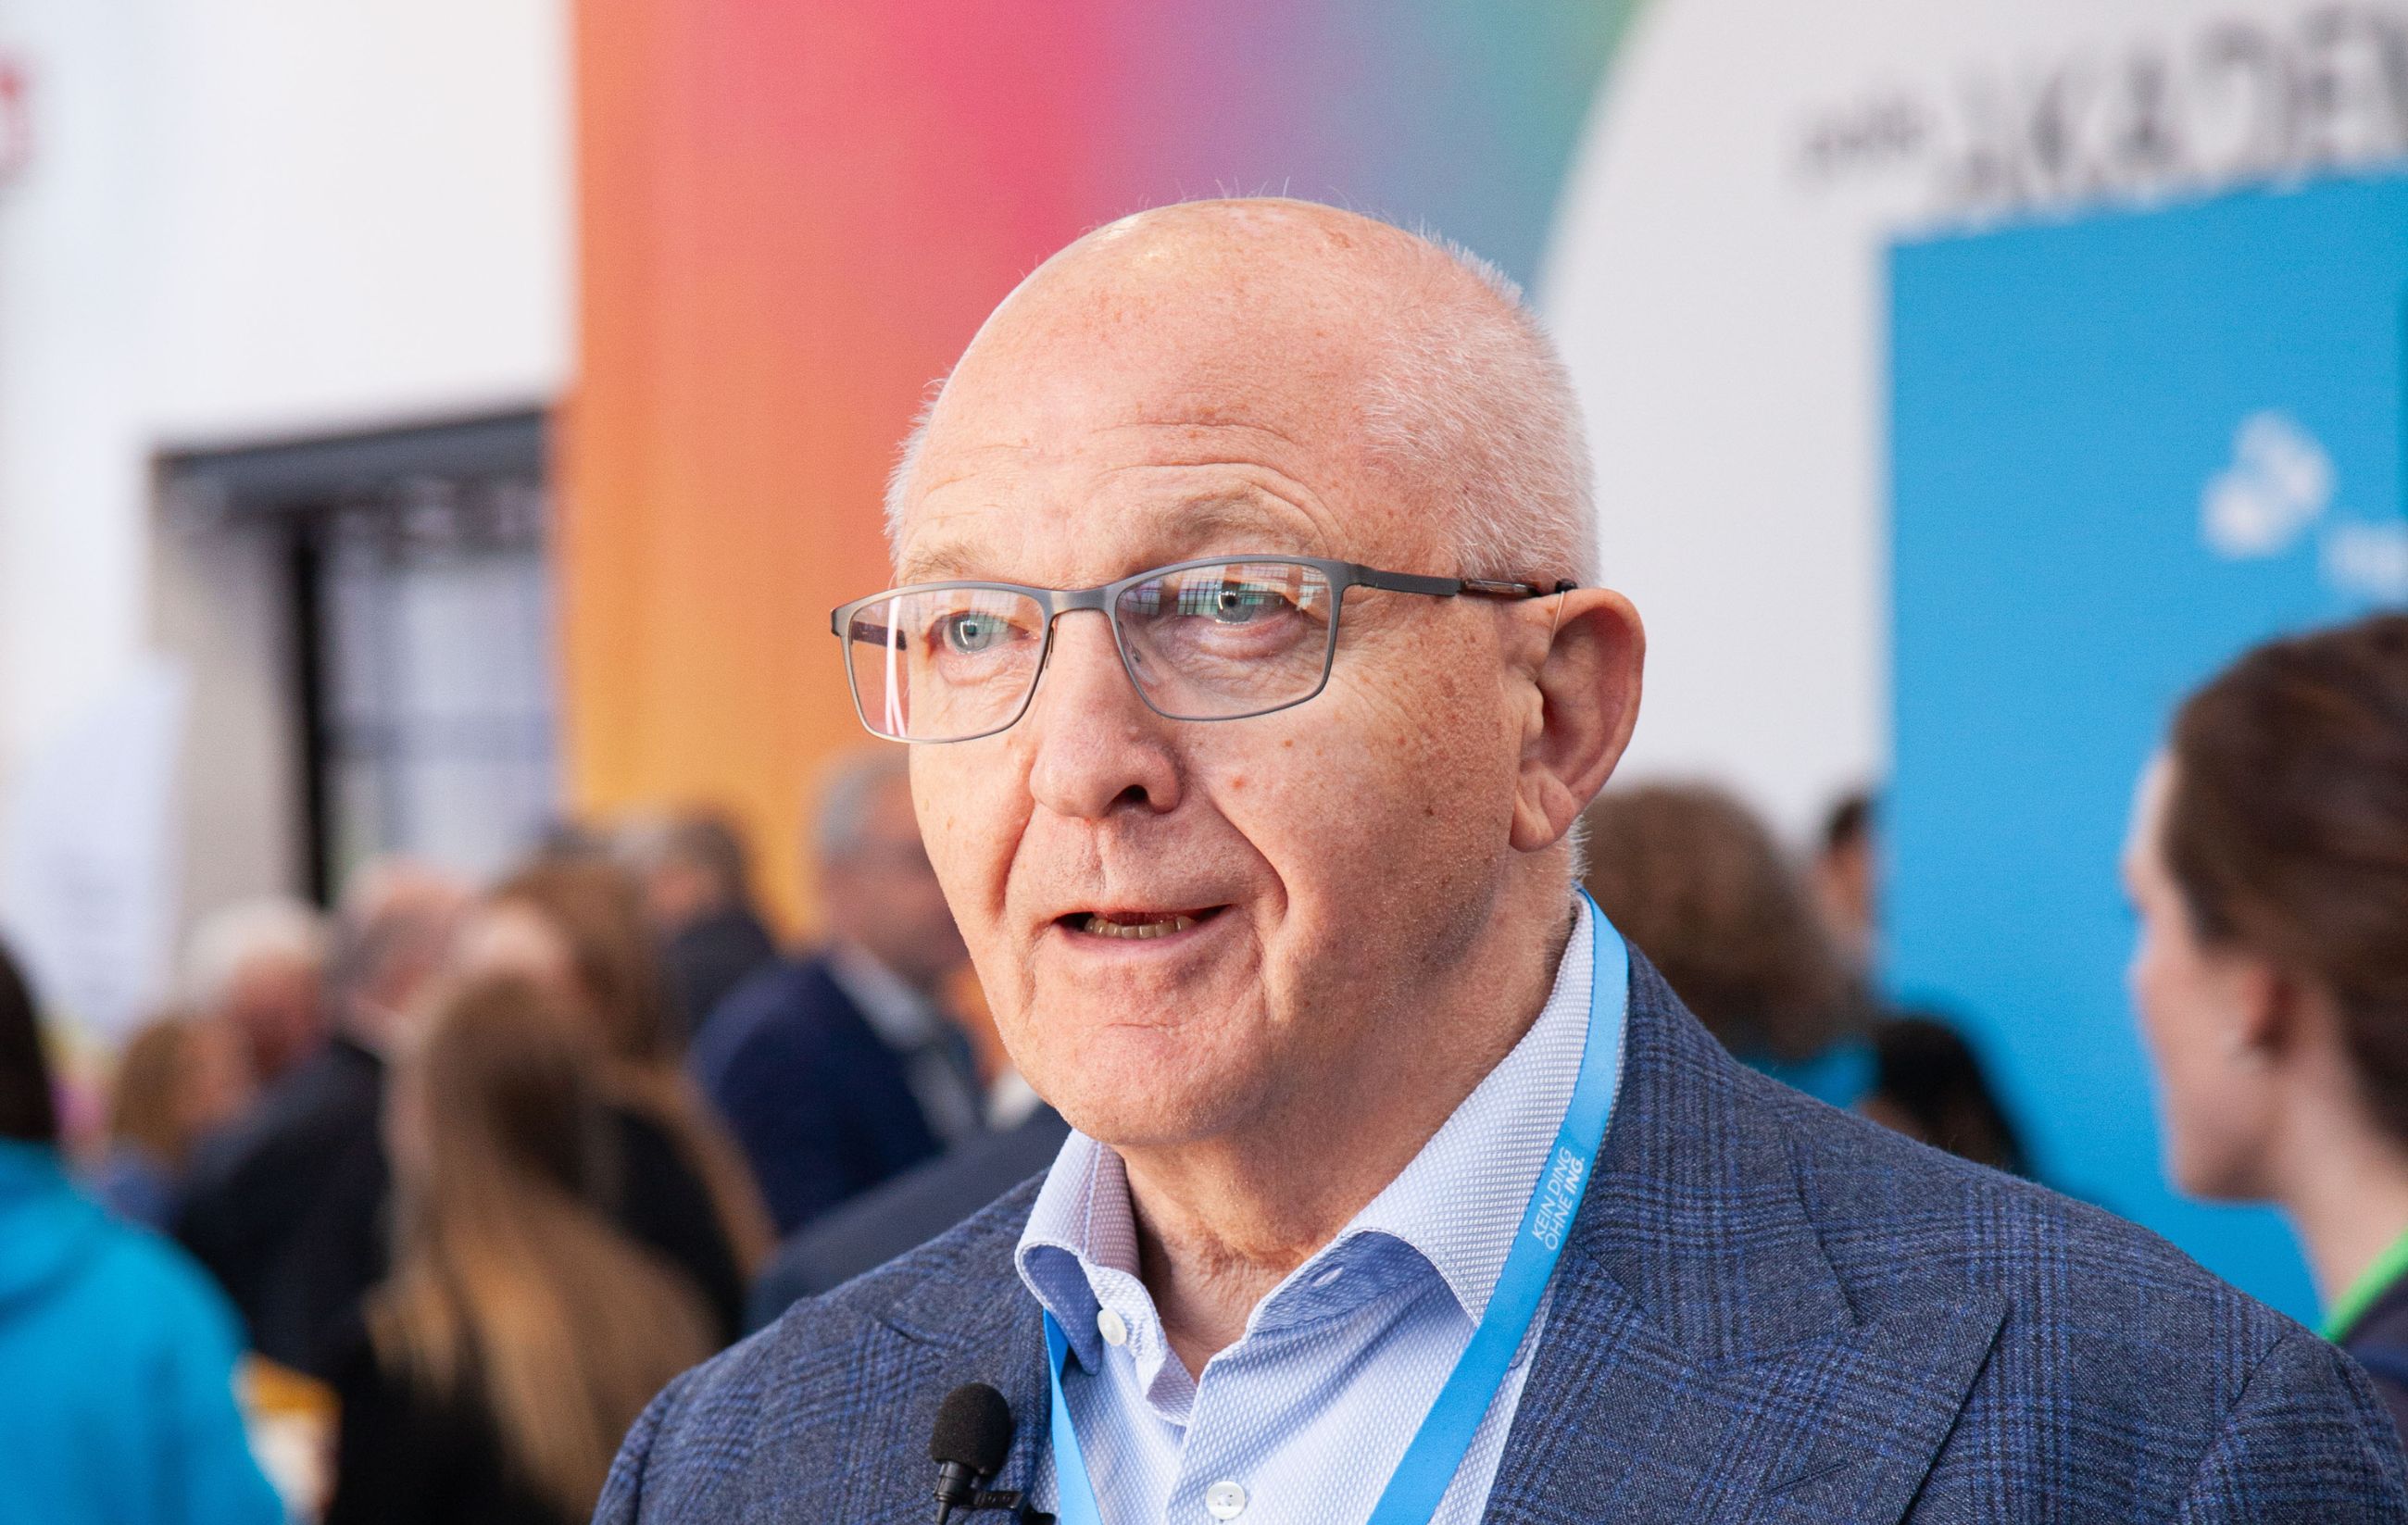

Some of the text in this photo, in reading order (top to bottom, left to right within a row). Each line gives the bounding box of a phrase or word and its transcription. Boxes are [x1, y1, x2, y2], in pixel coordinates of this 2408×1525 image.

[1532, 1146, 1572, 1241] KEIN DING
[1545, 1156, 1585, 1250] OHNE ING.
